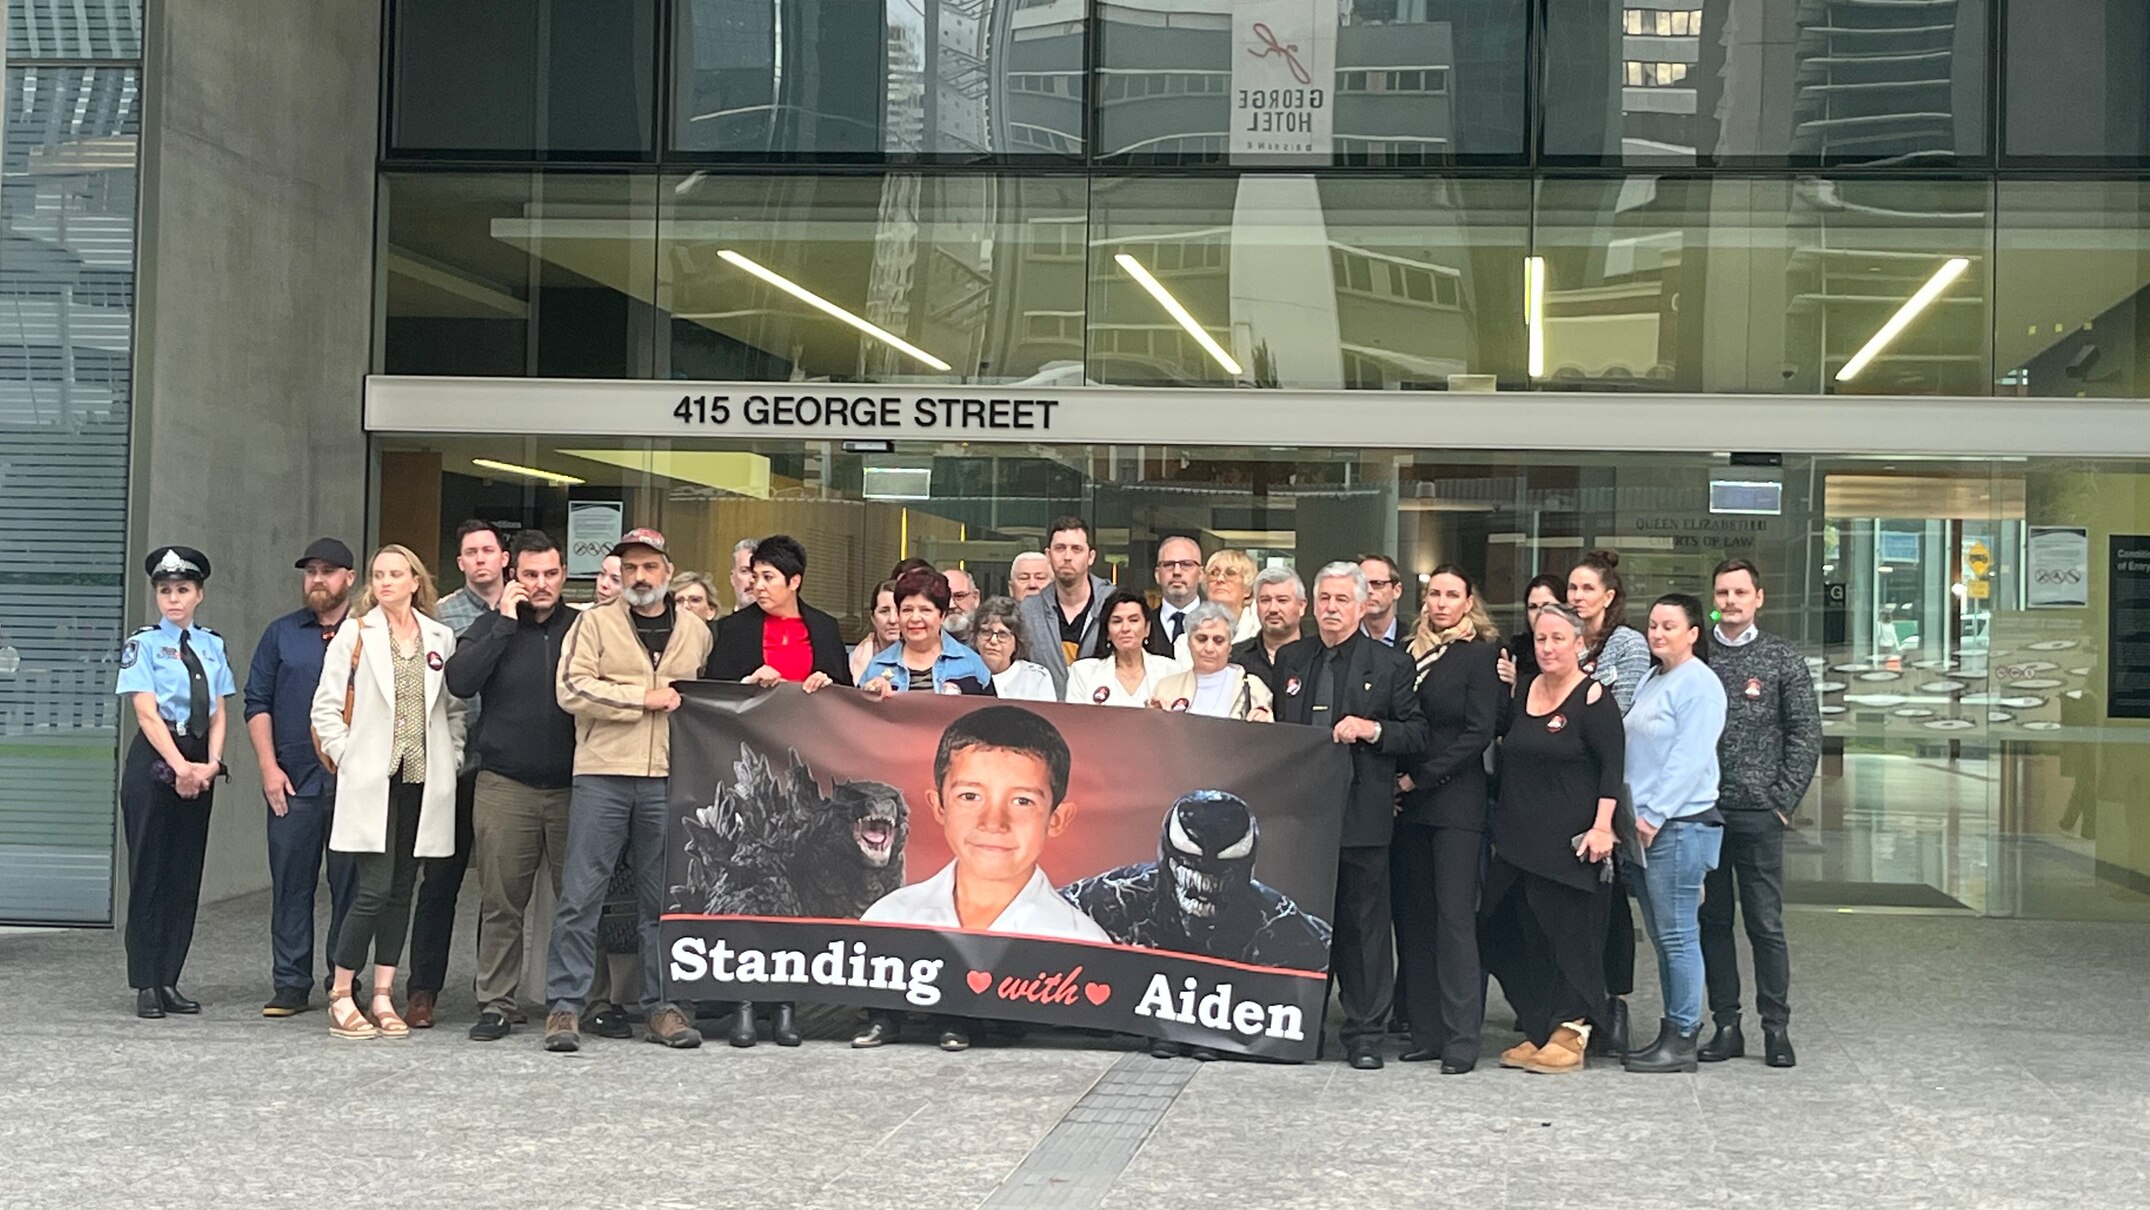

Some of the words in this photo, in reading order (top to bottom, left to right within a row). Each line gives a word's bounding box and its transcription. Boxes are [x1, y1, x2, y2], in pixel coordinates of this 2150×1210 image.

[673, 395, 730, 424] 415
[743, 396, 900, 426] GEORGE
[914, 398, 1059, 429] STREET
[1635, 517, 1679, 530] QUEEN
[1702, 535, 1720, 547] OF
[1724, 536, 1755, 547] LAW
[1830, 585, 1844, 600] G
[669, 936, 944, 1006] Standing
[997, 965, 1084, 1006] with
[1134, 973, 1305, 1041] Aiden
